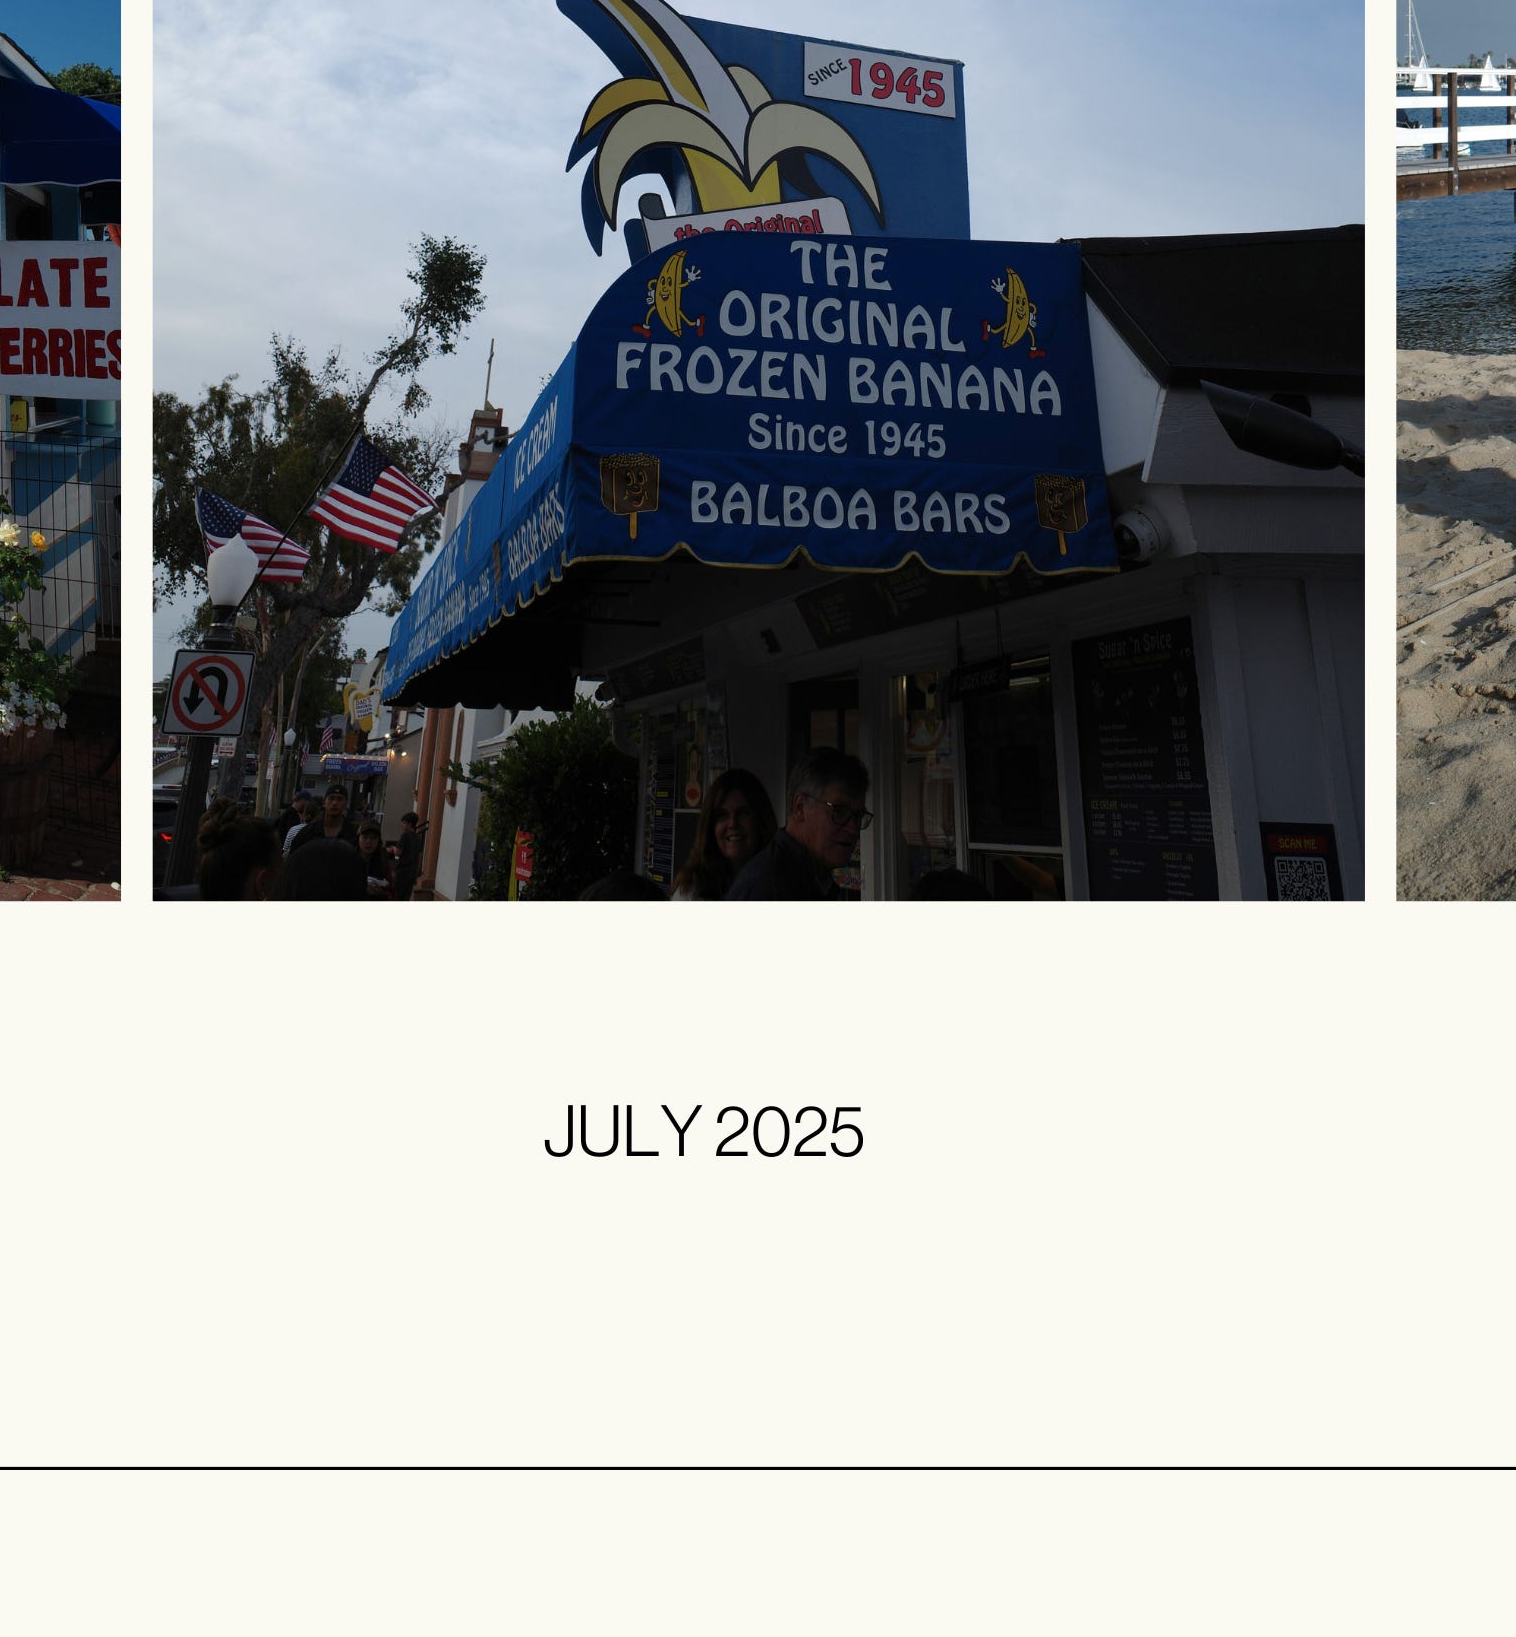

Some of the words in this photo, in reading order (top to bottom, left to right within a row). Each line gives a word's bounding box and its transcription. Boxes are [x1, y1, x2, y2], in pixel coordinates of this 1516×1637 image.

[808, 58, 848, 86] SINCE
[848, 58, 945, 108] 1945
[790, 240, 892, 292] THE
[719, 290, 966, 353] ORIGINAL
[616, 341, 827, 401] FROZEN
[849, 357, 1062, 417] BANANA
[526, 395, 558, 476] CREAM
[748, 412, 847, 455] Since
[864, 421, 947, 458] 1945
[690, 480, 877, 531] BALBOA
[893, 493, 1011, 535] BARS
[507, 518, 541, 582] BALBOA
[1278, 837, 1301, 850] SCAN
[1303, 838, 1318, 850] ME
